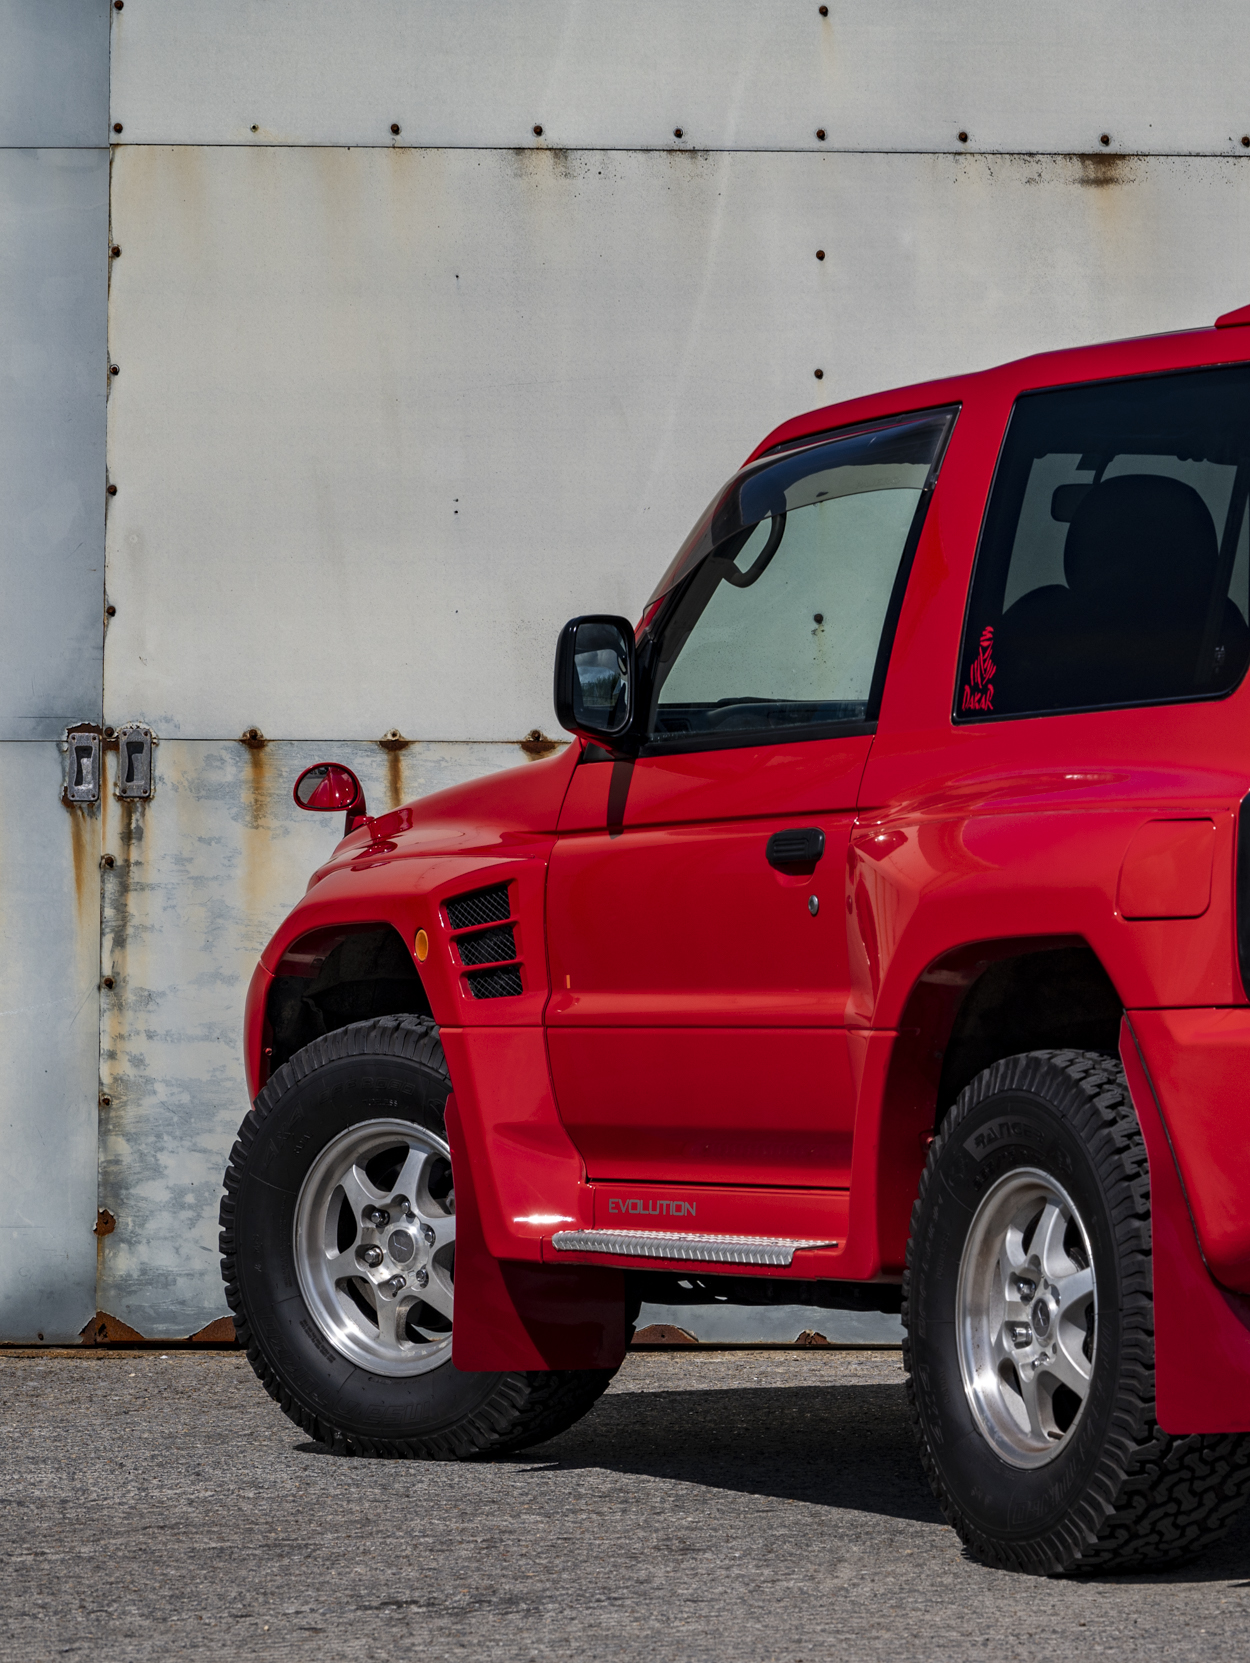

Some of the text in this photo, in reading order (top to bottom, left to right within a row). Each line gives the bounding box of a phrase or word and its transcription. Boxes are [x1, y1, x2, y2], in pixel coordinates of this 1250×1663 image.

[961, 683, 995, 711] DAKAR
[973, 1121, 1046, 1150] RANGER
[608, 1198, 697, 1217] EVOLUTION
